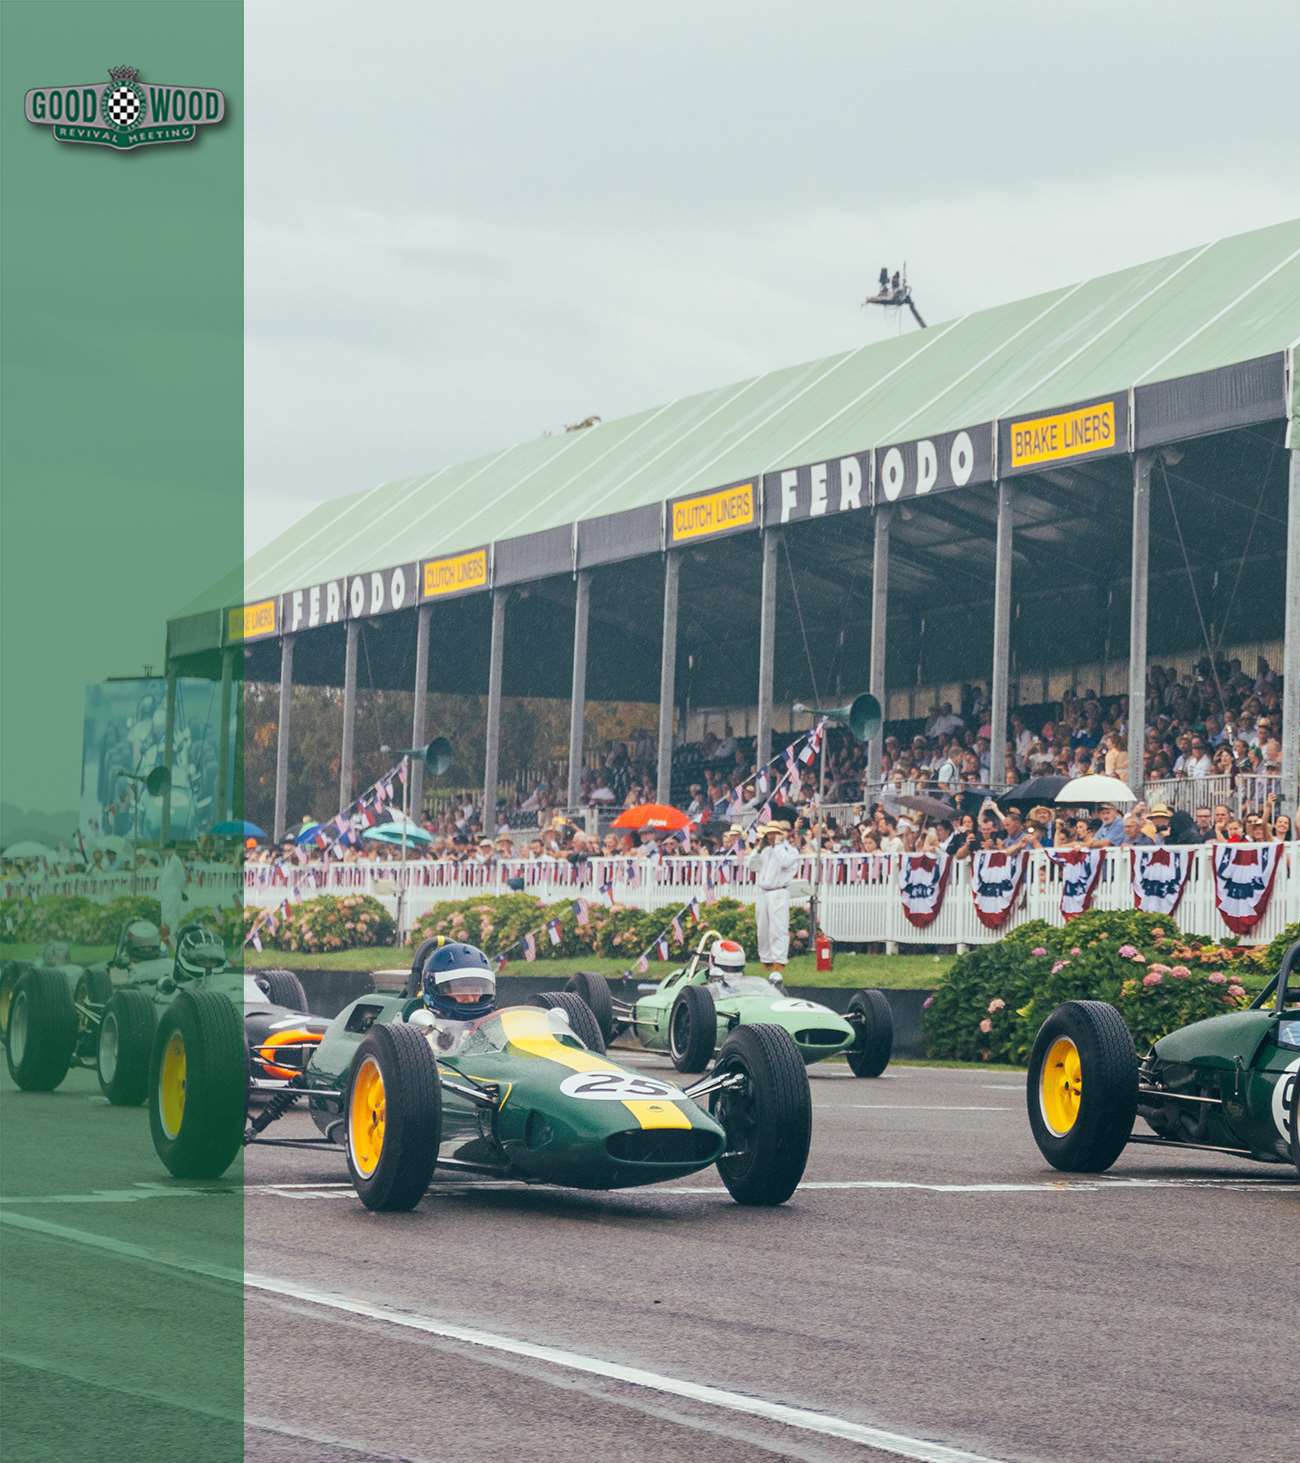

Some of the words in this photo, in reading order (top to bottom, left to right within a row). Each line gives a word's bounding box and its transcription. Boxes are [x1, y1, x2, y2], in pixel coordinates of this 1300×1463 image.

[1015, 424, 1058, 457] BRAKE
[1063, 411, 1111, 448] LINERS
[780, 431, 974, 523] FERODO
[675, 502, 712, 532] CLUTCH
[716, 491, 750, 522] LINERS
[425, 562, 454, 587] CLUTCH
[457, 557, 482, 582] LINERS
[291, 567, 406, 632] FERODO
[573, 1073, 674, 1096] 25
